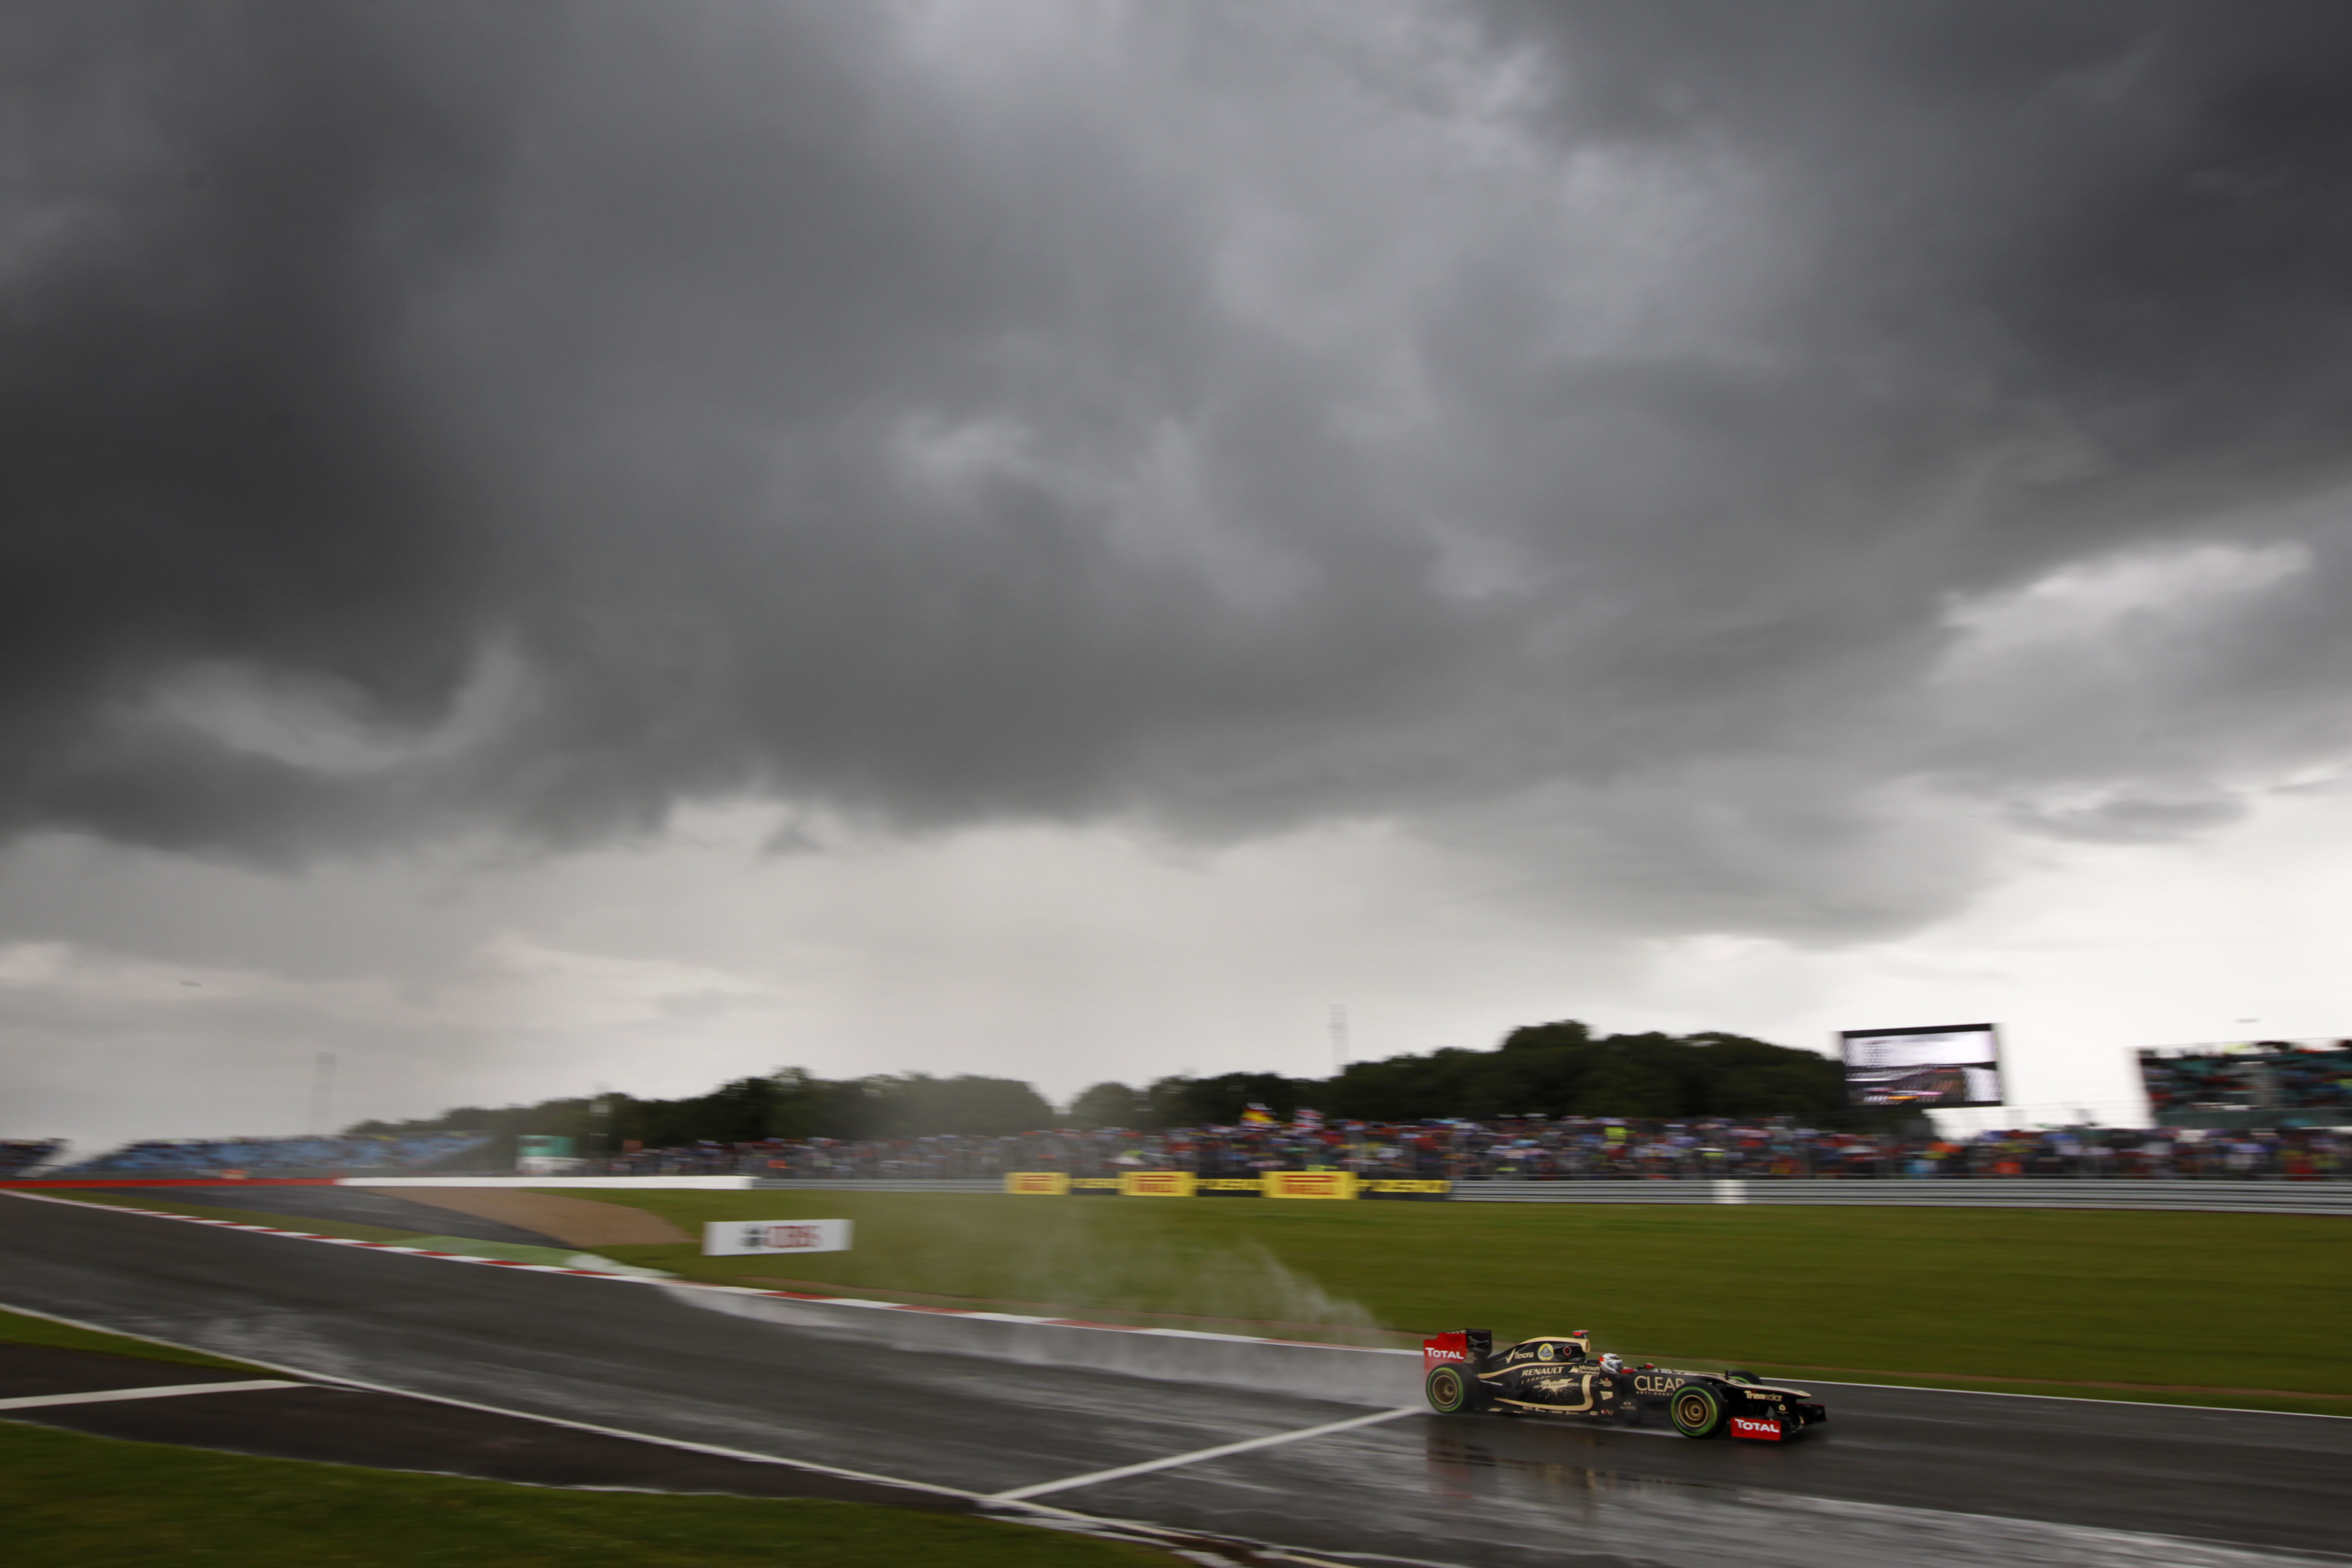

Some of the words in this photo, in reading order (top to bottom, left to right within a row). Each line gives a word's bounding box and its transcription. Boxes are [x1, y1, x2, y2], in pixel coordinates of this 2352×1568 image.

[1425, 1347, 1464, 1360] TOTAL
[1522, 1366, 1564, 1376] RENAULT
[1735, 1418, 1779, 1433] TOTAL
